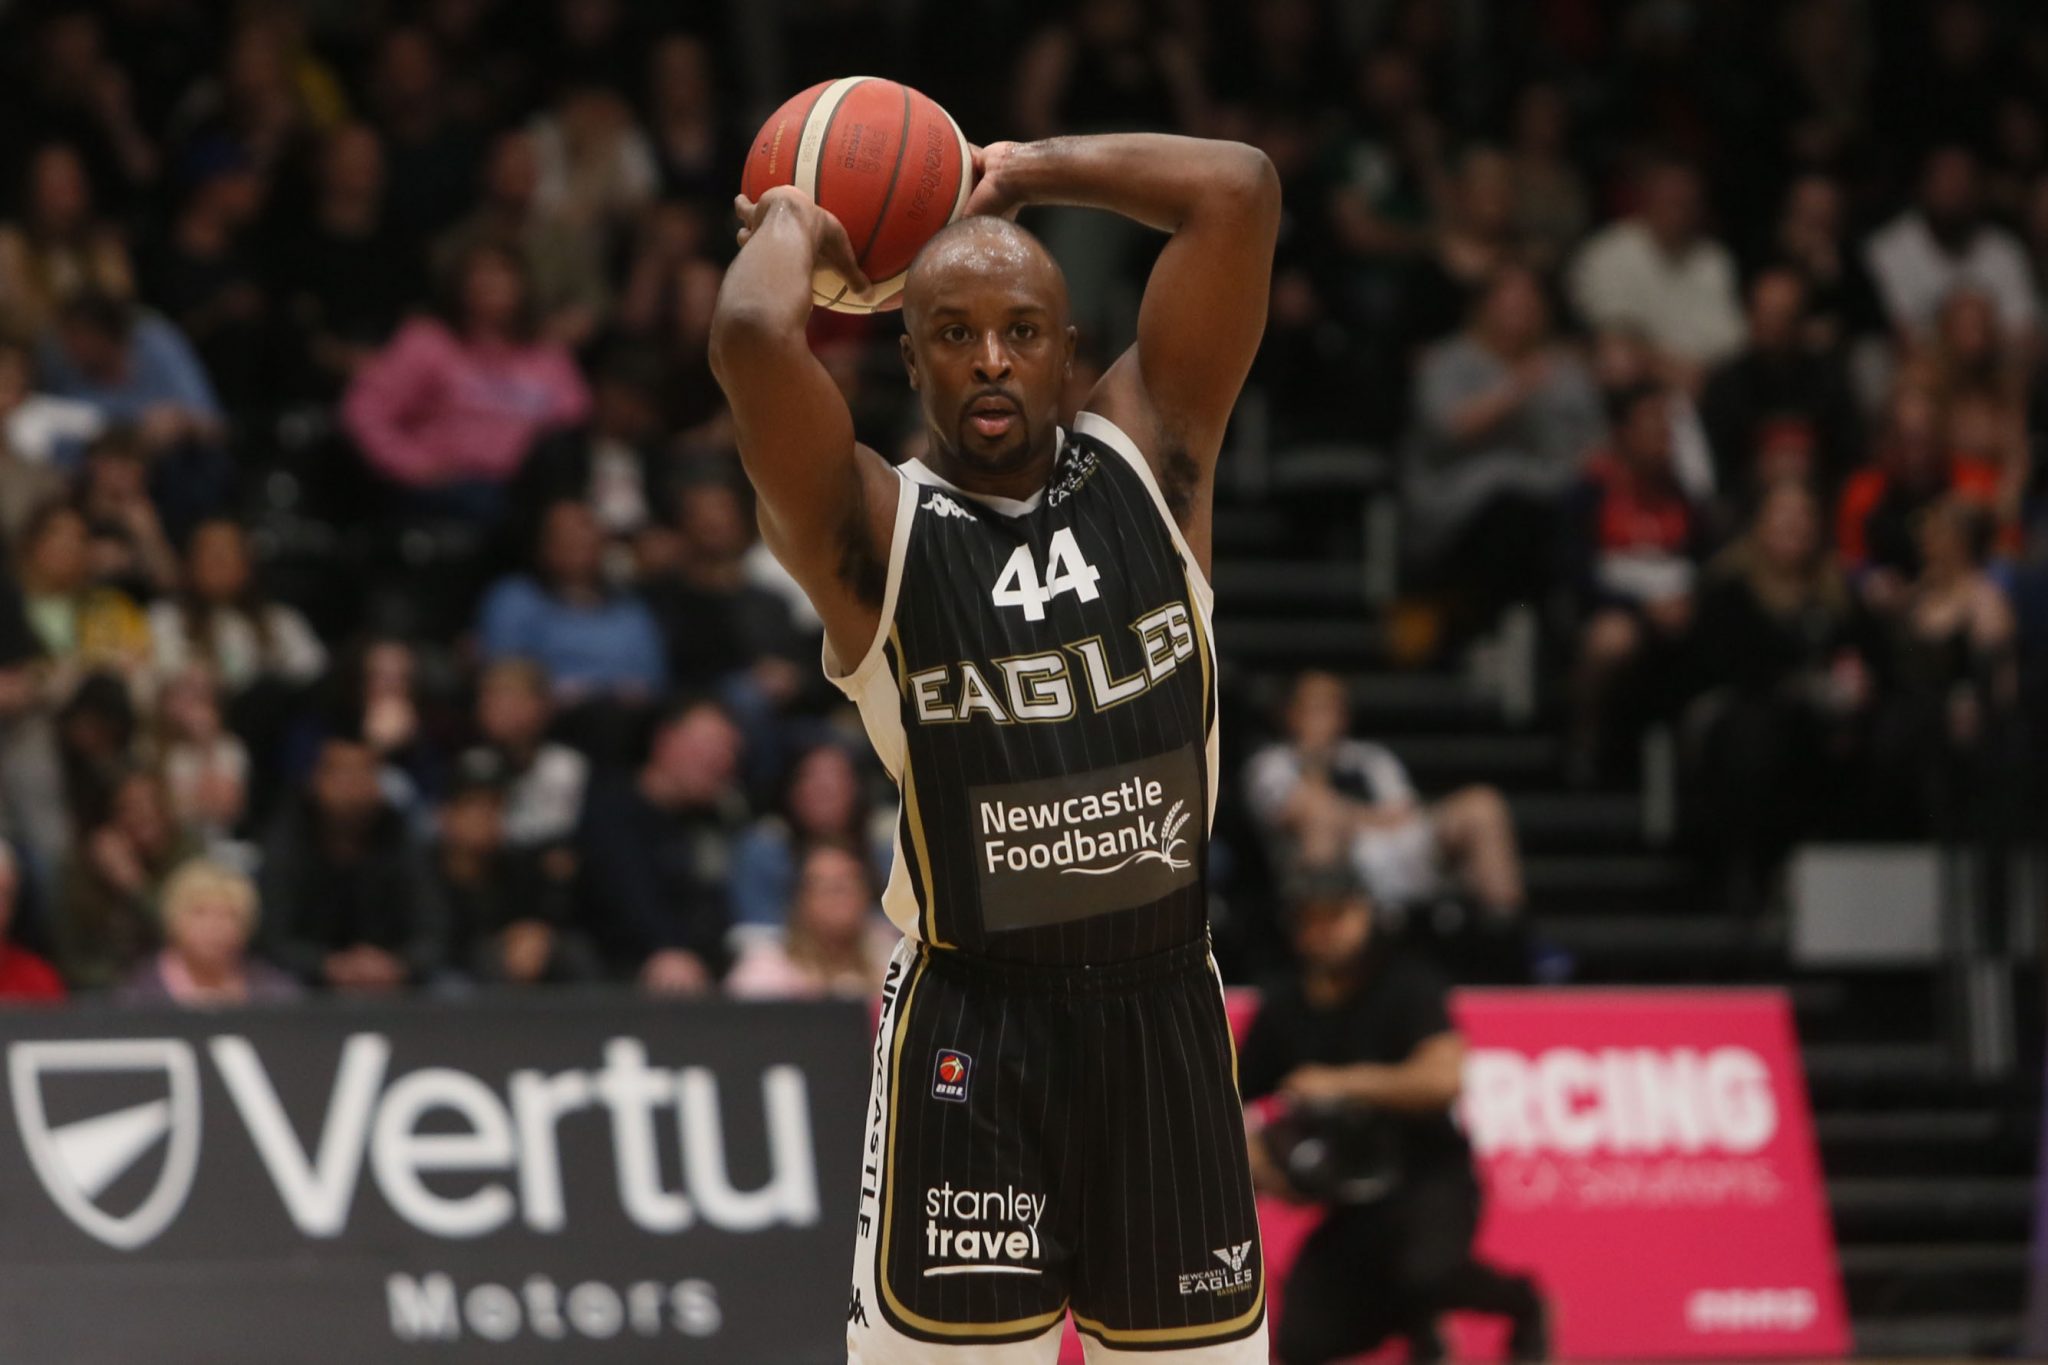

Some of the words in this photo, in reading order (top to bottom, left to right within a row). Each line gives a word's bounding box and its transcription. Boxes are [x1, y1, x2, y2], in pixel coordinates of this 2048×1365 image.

[992, 526, 1100, 621] 44
[908, 601, 1194, 724] EAGLES
[980, 776, 1162, 835] Newcastle
[985, 815, 1159, 874] Foodbank
[935, 1083, 964, 1097] BBL
[1454, 1045, 1778, 1156] RCING
[208, 1032, 818, 1238] Vertu
[926, 1181, 1047, 1228] stanley
[926, 1219, 1040, 1259] travel
[1178, 1268, 1227, 1281] NEWCASTLE
[1180, 1268, 1252, 1295] EAGLES
[385, 1270, 722, 1342] Motors
